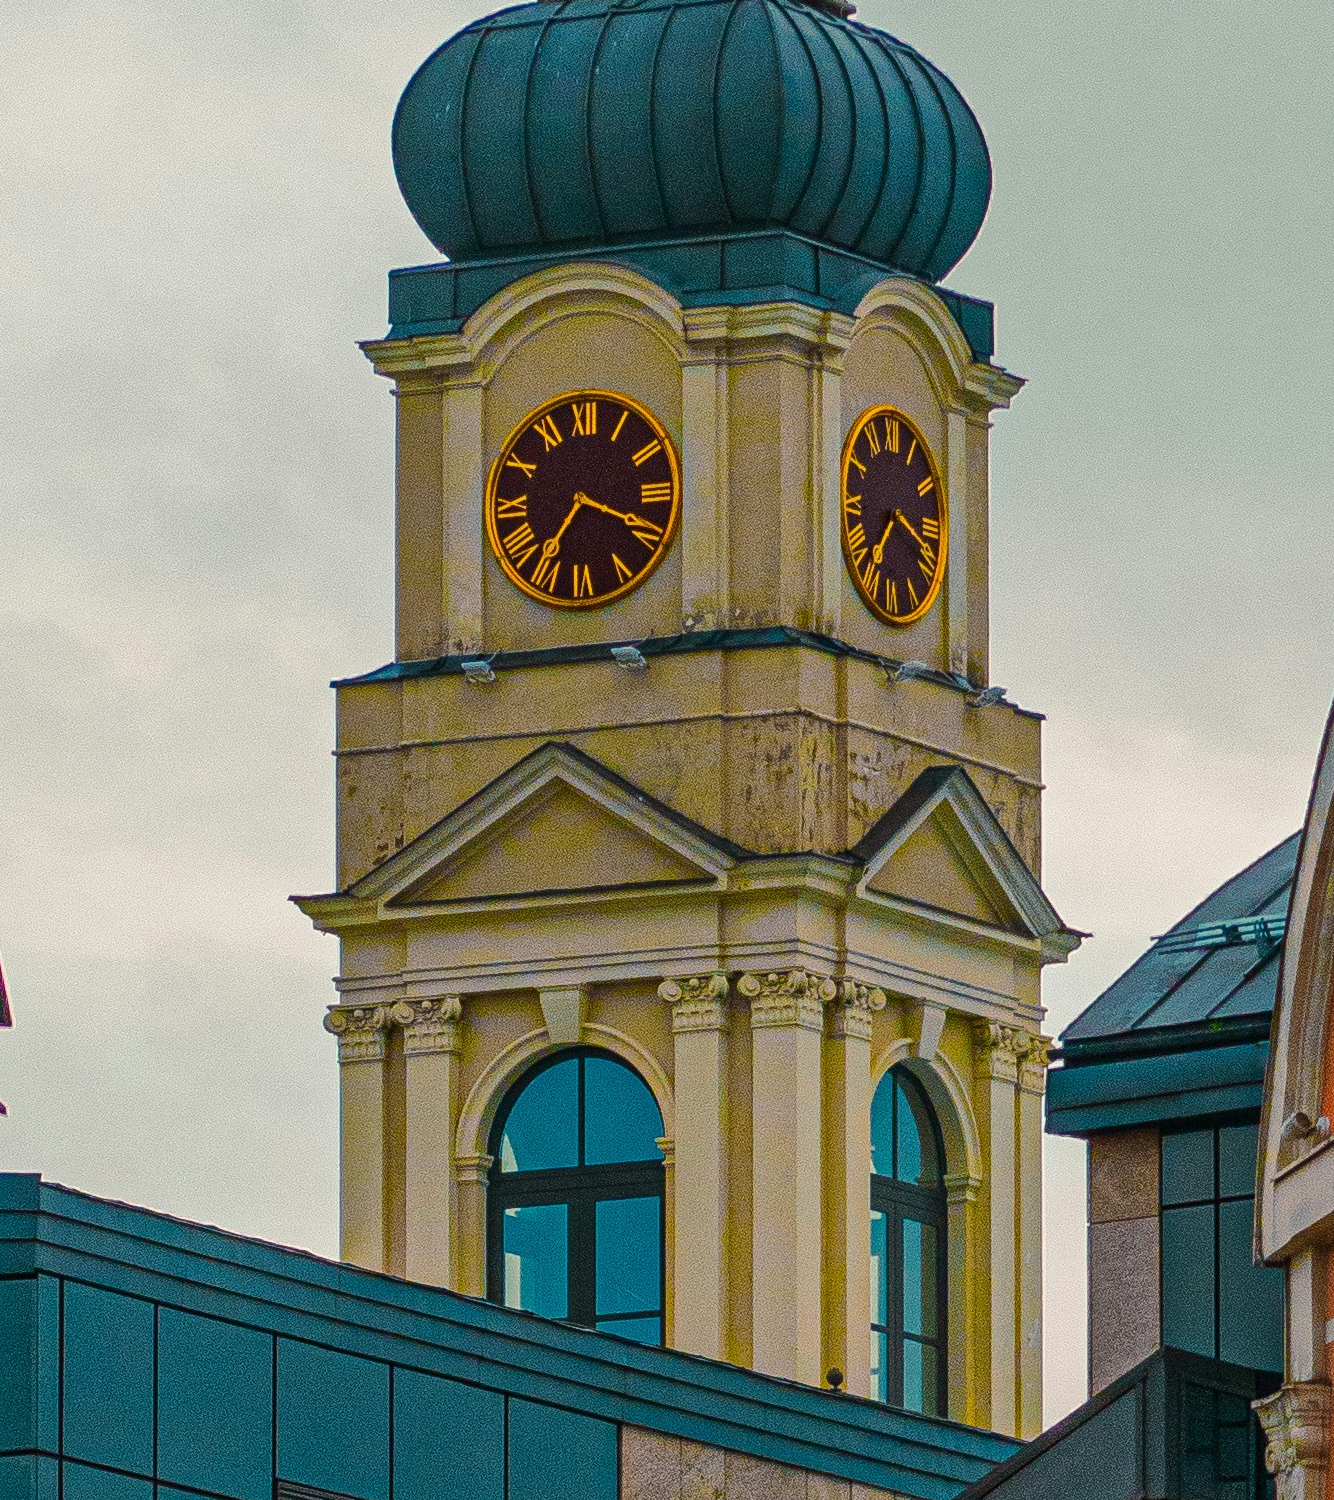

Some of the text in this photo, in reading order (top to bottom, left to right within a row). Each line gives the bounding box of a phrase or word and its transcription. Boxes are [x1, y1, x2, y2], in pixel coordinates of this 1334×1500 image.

[533, 415, 563, 452] XI
[571, 401, 597, 437] XII
[506, 452, 537, 478] X
[631, 439, 662, 467] II
[640, 482, 671, 503] III
[885, 417, 900, 454] XII
[922, 517, 939, 539] III
[497, 495, 527, 519] IX
[573, 564, 594, 598] VI
